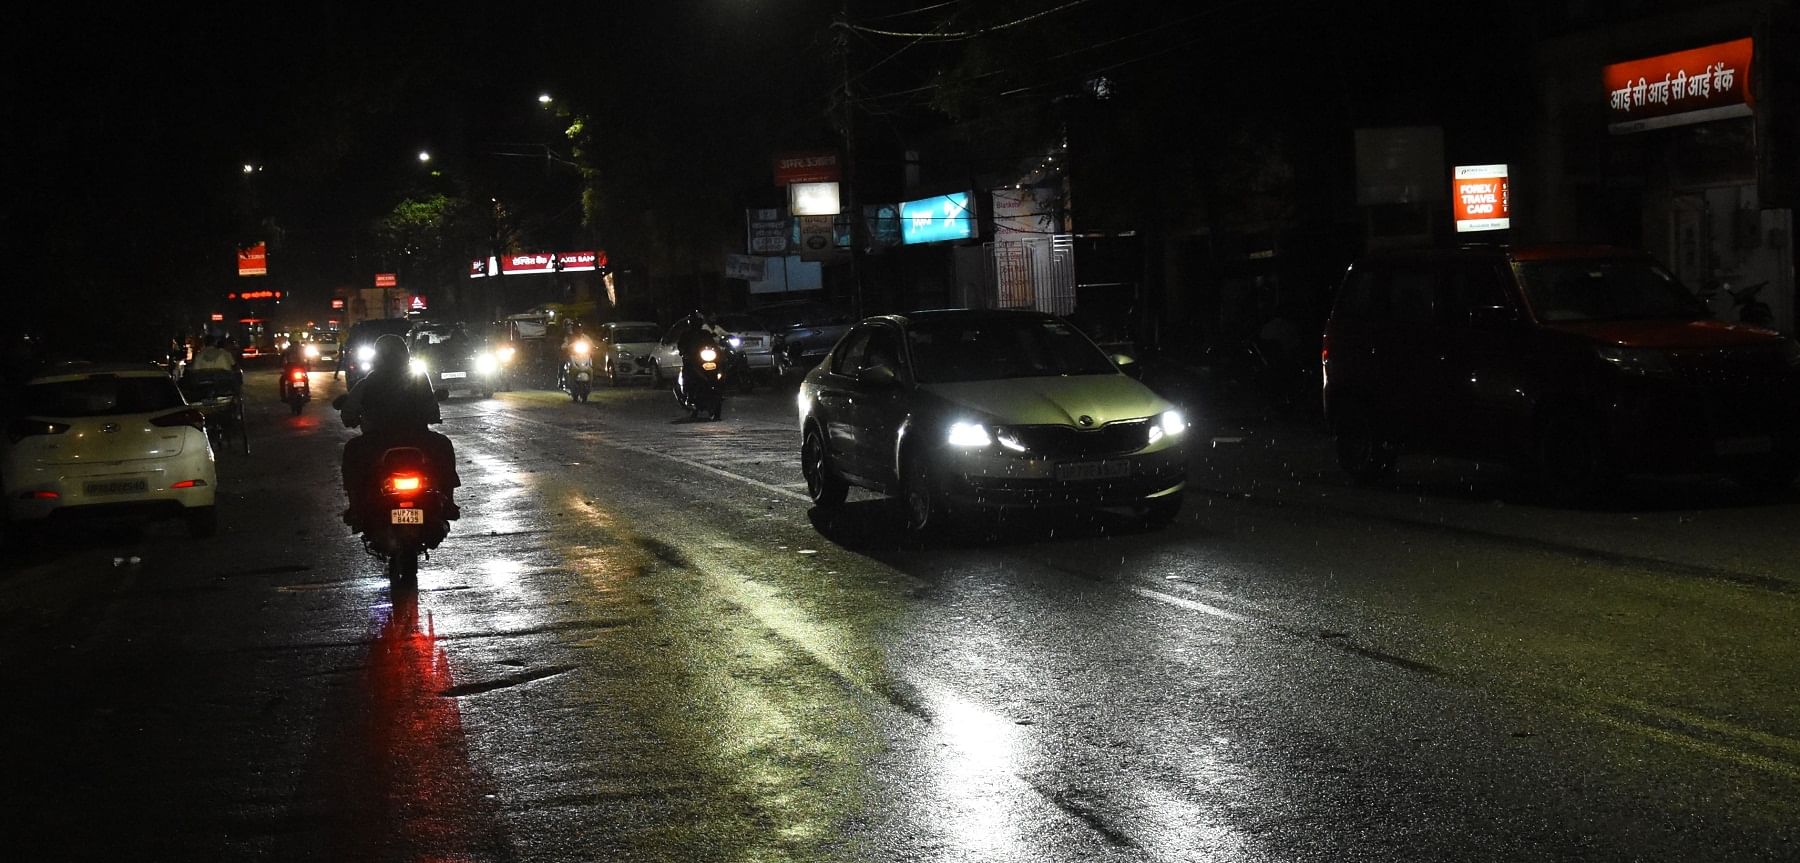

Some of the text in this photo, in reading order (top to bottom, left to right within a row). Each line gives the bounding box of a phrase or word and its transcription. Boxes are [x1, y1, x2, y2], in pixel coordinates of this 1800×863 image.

[1610, 62, 1734, 112] आई सी आई सी आई बैंक
[1460, 184, 1491, 194] FOREX
[1461, 194, 1497, 204] TRAVEL
[1467, 204, 1493, 214] CARD
